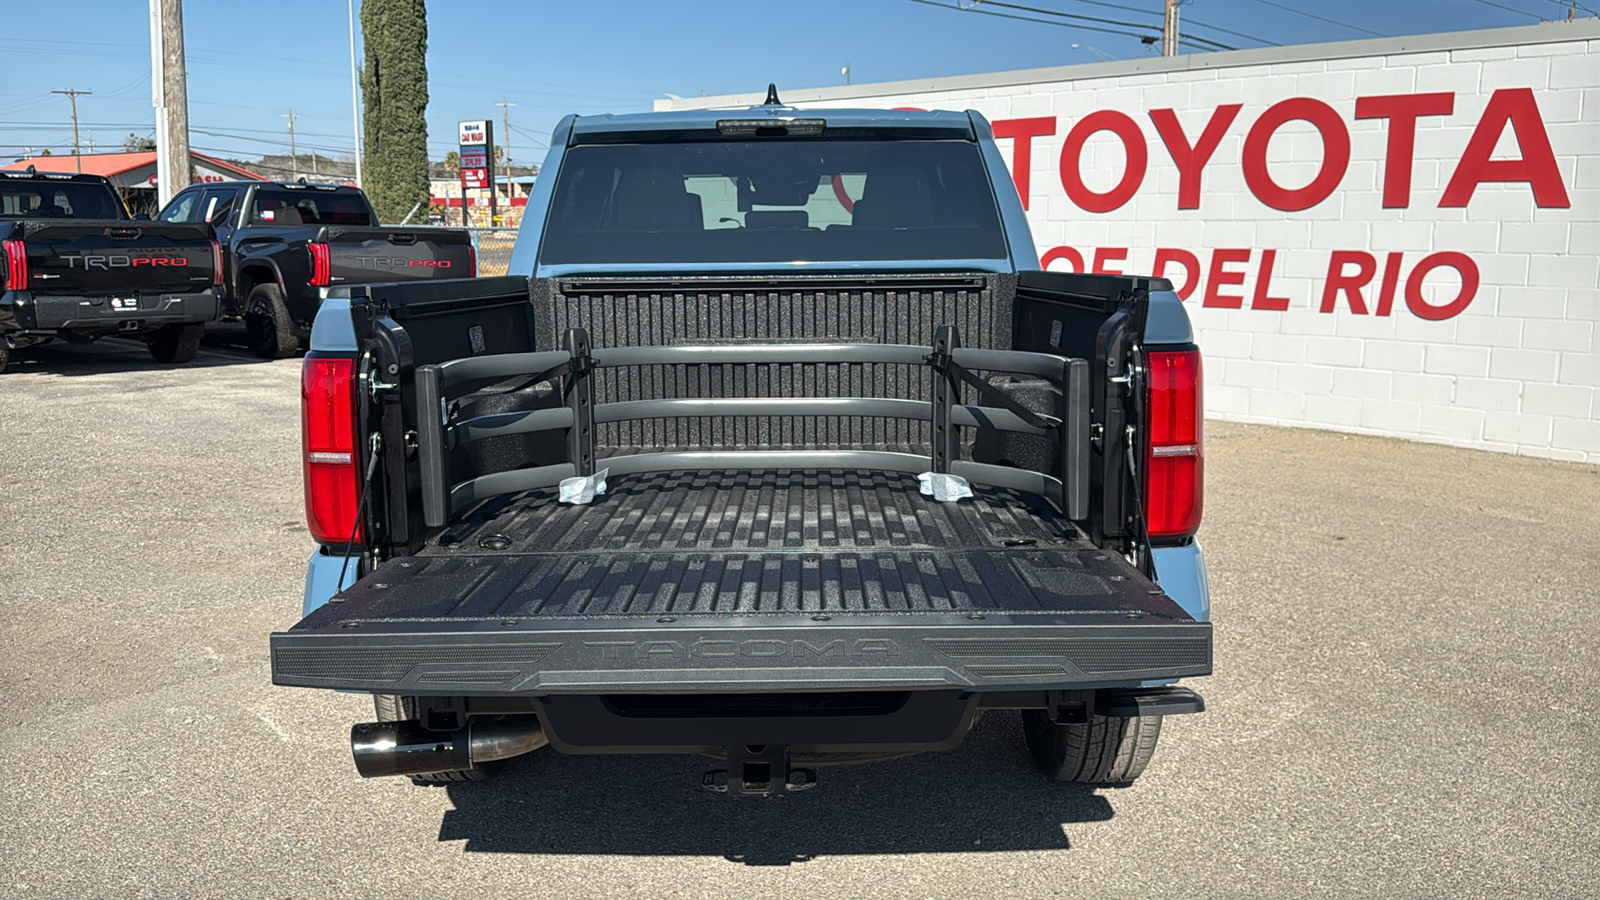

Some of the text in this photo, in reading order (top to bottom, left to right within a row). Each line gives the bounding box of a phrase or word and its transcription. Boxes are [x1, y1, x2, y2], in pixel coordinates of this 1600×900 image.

[991, 87, 1571, 213] TOYOTA
[1152, 247, 1290, 311] DEL
[1319, 250, 1480, 320] RIO
[583, 638, 899, 660] TACOMA
